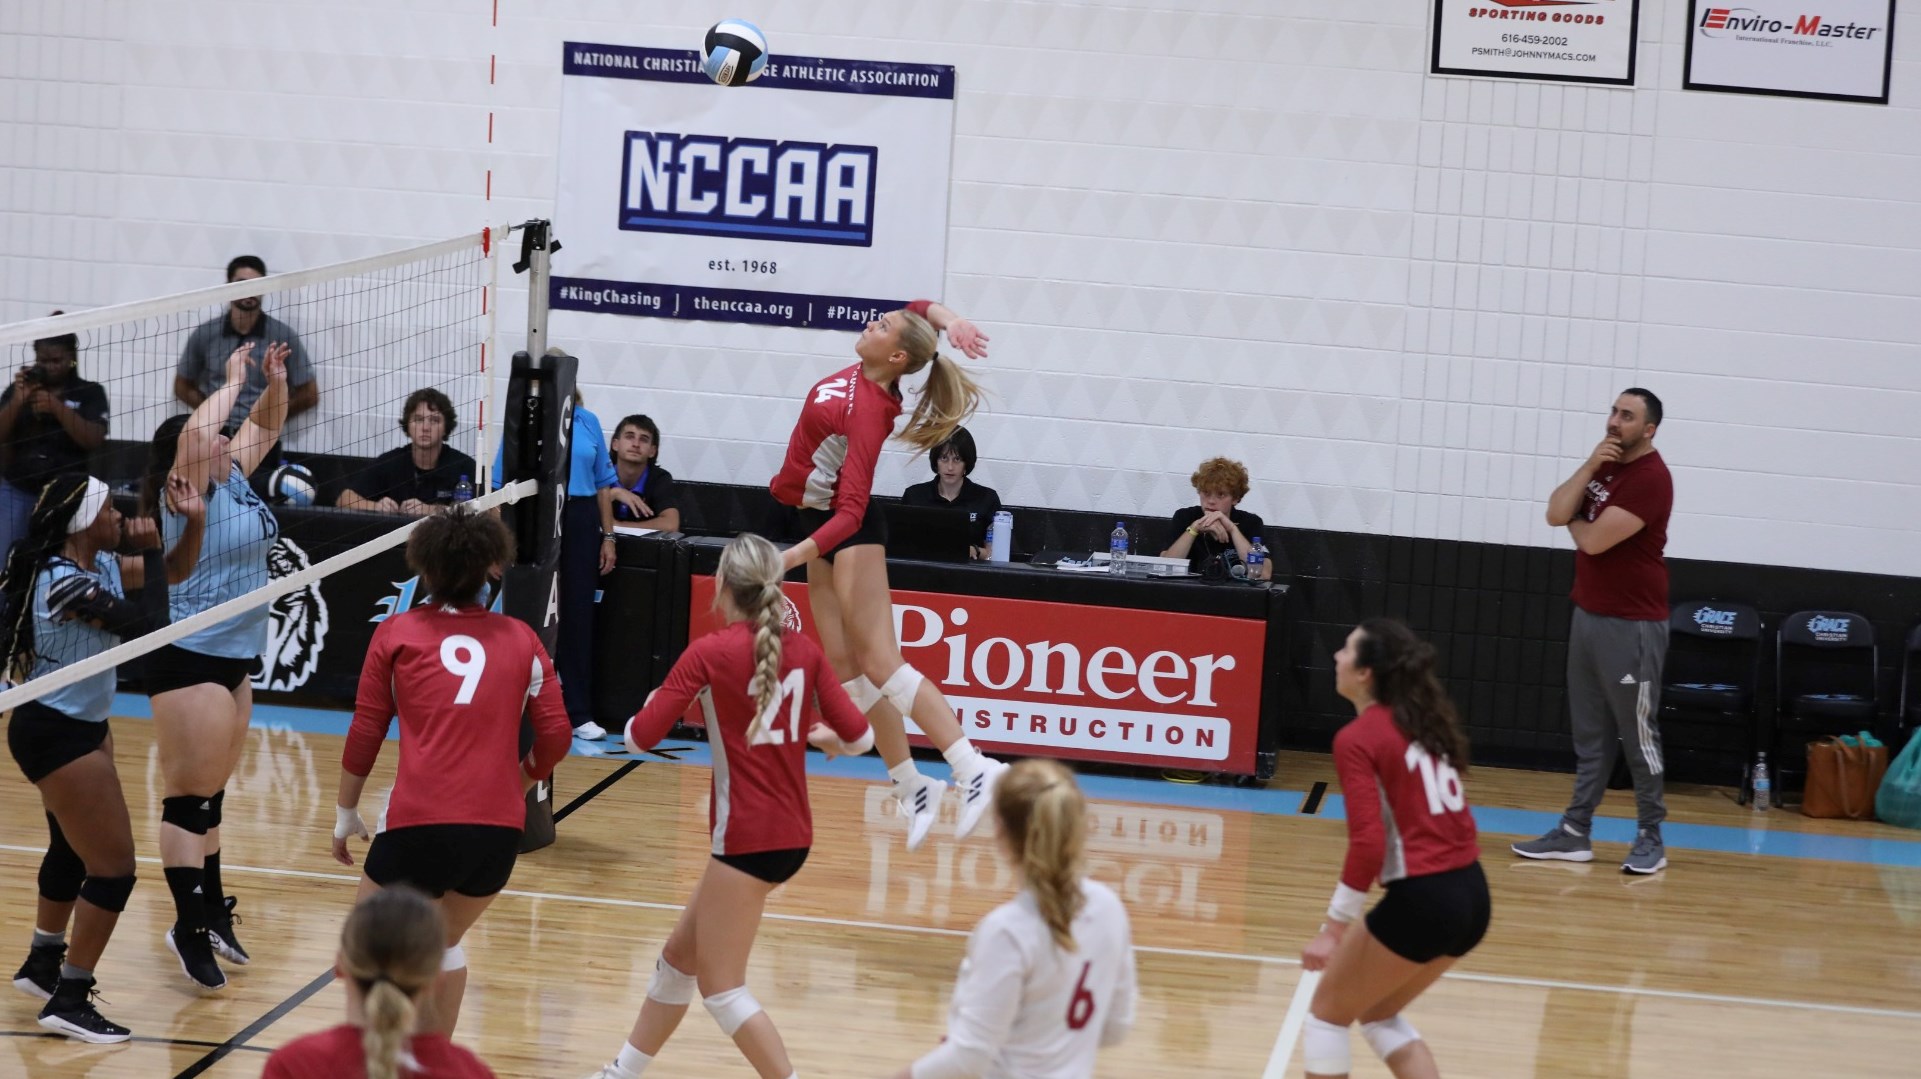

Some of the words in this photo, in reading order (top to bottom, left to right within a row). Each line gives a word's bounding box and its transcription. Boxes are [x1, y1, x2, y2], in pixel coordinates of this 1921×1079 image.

[1468, 7, 1547, 22] SPORTING
[1551, 13, 1604, 25] GOODS
[1699, 8, 1877, 40] Enviro-Master
[1471, 47, 1596, 62] PSMITH@JOHNNYMACS.COM
[1501, 33, 1568, 46] 616-459-2002
[1735, 34, 1779, 44] International
[573, 51, 639, 70] NATIONAL
[643, 57, 706, 74] CHRISTIA
[782, 65, 846, 82] ATHLETIC
[850, 70, 940, 87] ASSOCIATION
[626, 137, 871, 225] NCCAA
[708, 259, 736, 272] est.
[742, 260, 777, 274] 1968
[559, 286, 661, 309] #KingChasing
[694, 297, 793, 319] thenccaa.org
[814, 378, 848, 404] 14
[1693, 606, 1738, 625] GRACE
[1806, 614, 1850, 632] GRACE
[440, 634, 487, 705] 9
[891, 603, 1236, 707] Pioneer
[747, 668, 805, 746] 21
[1404, 741, 1465, 815] 16
[1066, 960, 1095, 1030] 6
